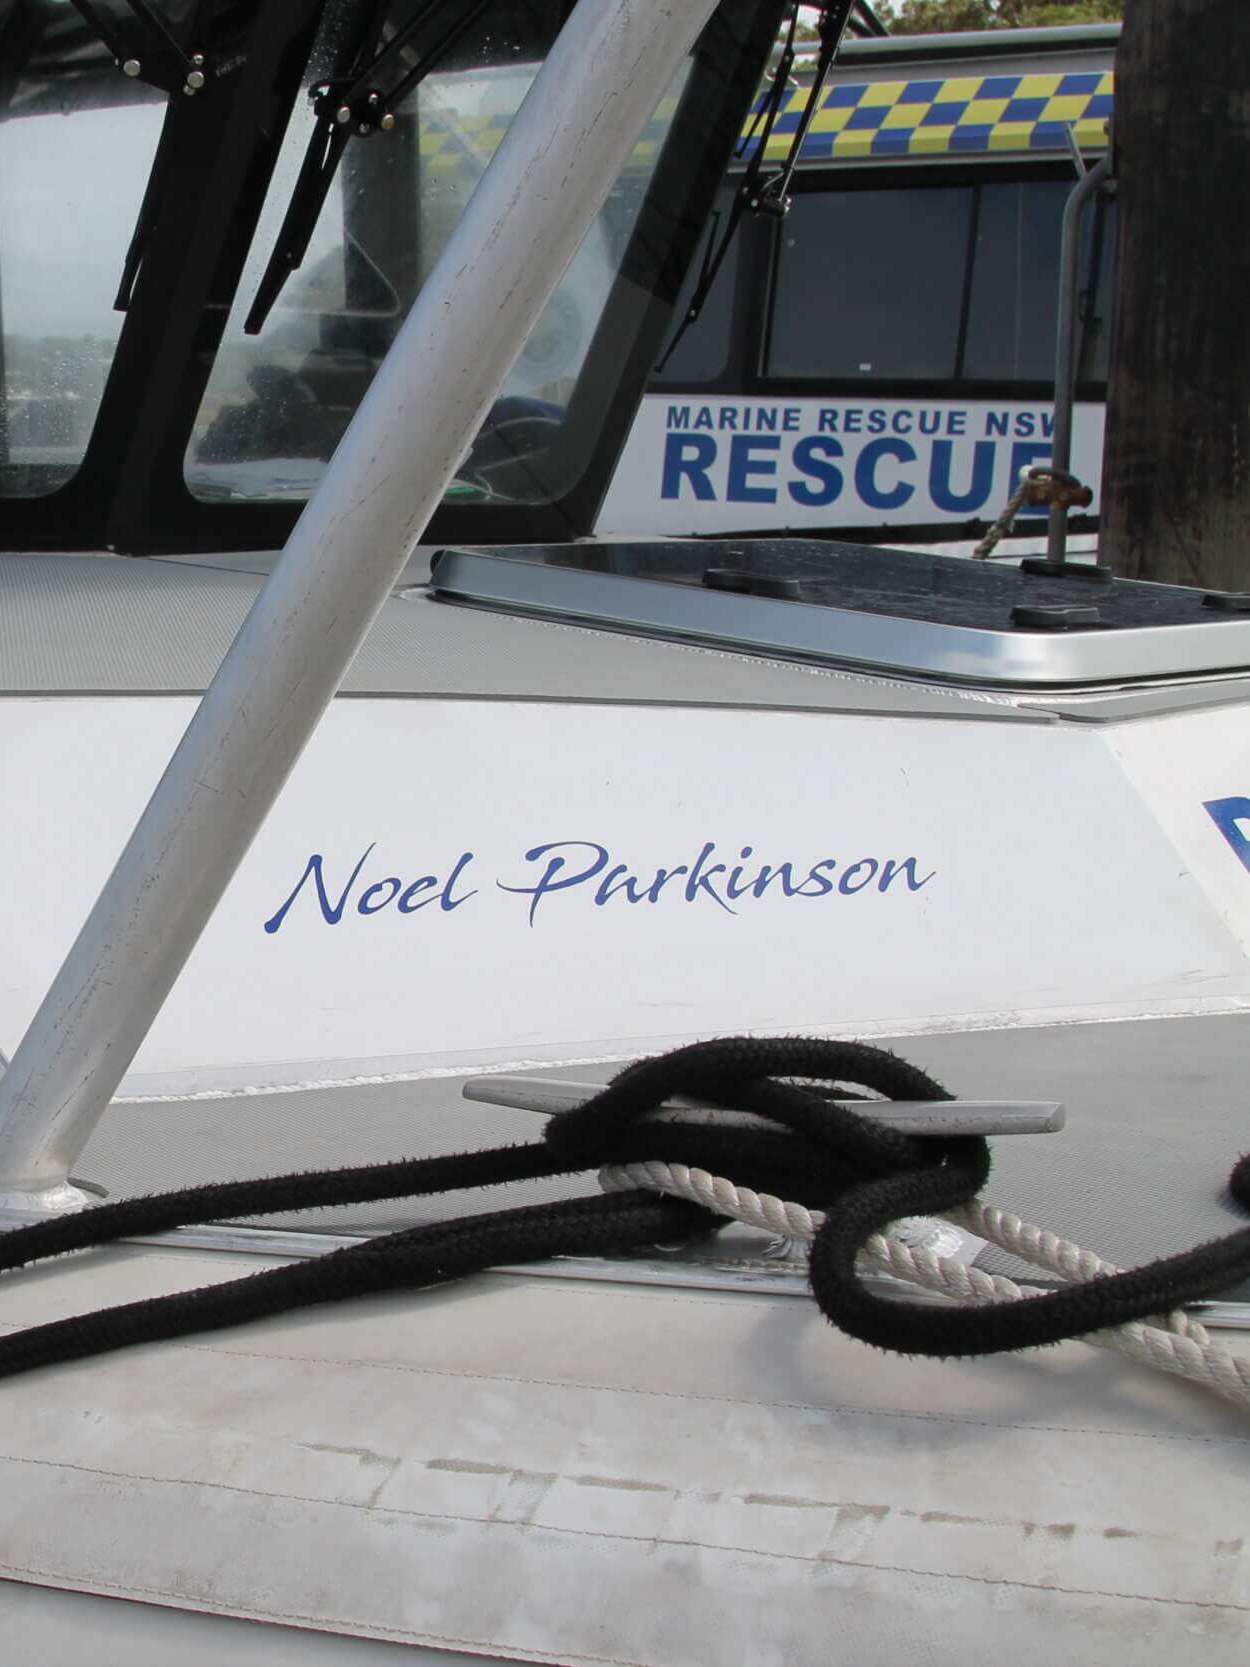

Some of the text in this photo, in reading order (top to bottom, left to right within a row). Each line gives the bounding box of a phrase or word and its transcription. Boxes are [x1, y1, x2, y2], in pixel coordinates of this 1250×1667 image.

[666, 406, 801, 432] MARINE
[817, 408, 968, 435] RESCUE
[263, 841, 937, 934] Noel Parkinson
